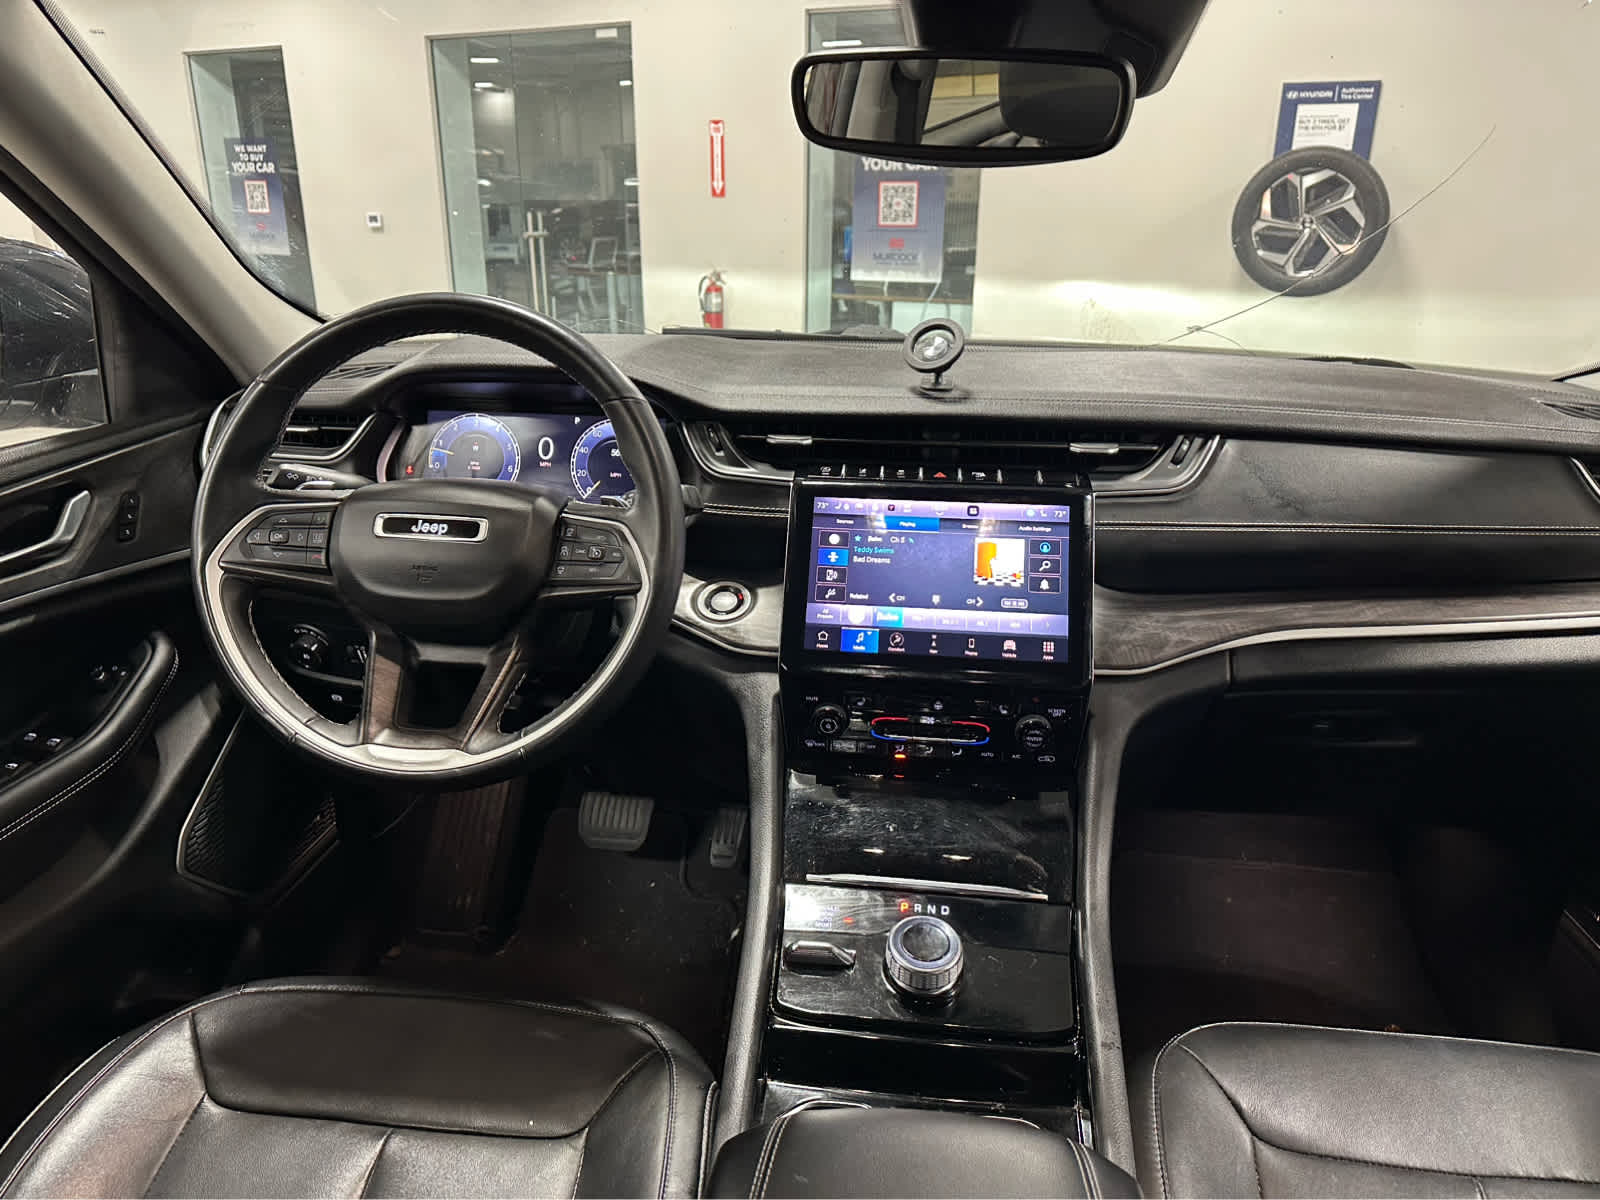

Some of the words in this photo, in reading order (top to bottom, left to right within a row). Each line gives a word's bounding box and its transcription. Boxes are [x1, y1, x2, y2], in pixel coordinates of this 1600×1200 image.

[233, 143, 245, 152] WE
[246, 144, 267, 153] WANT
[240, 153, 249, 161] TO
[250, 153, 264, 161] BUY
[232, 161, 257, 173] YOUR
[256, 162, 275, 174] CAR
[861, 156, 903, 171] YOUR
[574, 416, 581, 425] P
[592, 430, 602, 438] 60
[538, 436, 554, 460] 0
[579, 446, 589, 454] 40
[434, 461, 440, 469] 0
[507, 464, 514, 473] 6
[577, 469, 587, 477] 20
[410, 519, 449, 536] Jeep
[854, 546, 873, 554] Teddy
[852, 555, 866, 563] Bad
[866, 556, 891, 564] Dreams
[900, 902, 909, 912] P
[914, 903, 922, 913] R
[927, 904, 937, 914] N
[940, 905, 950, 915] D
